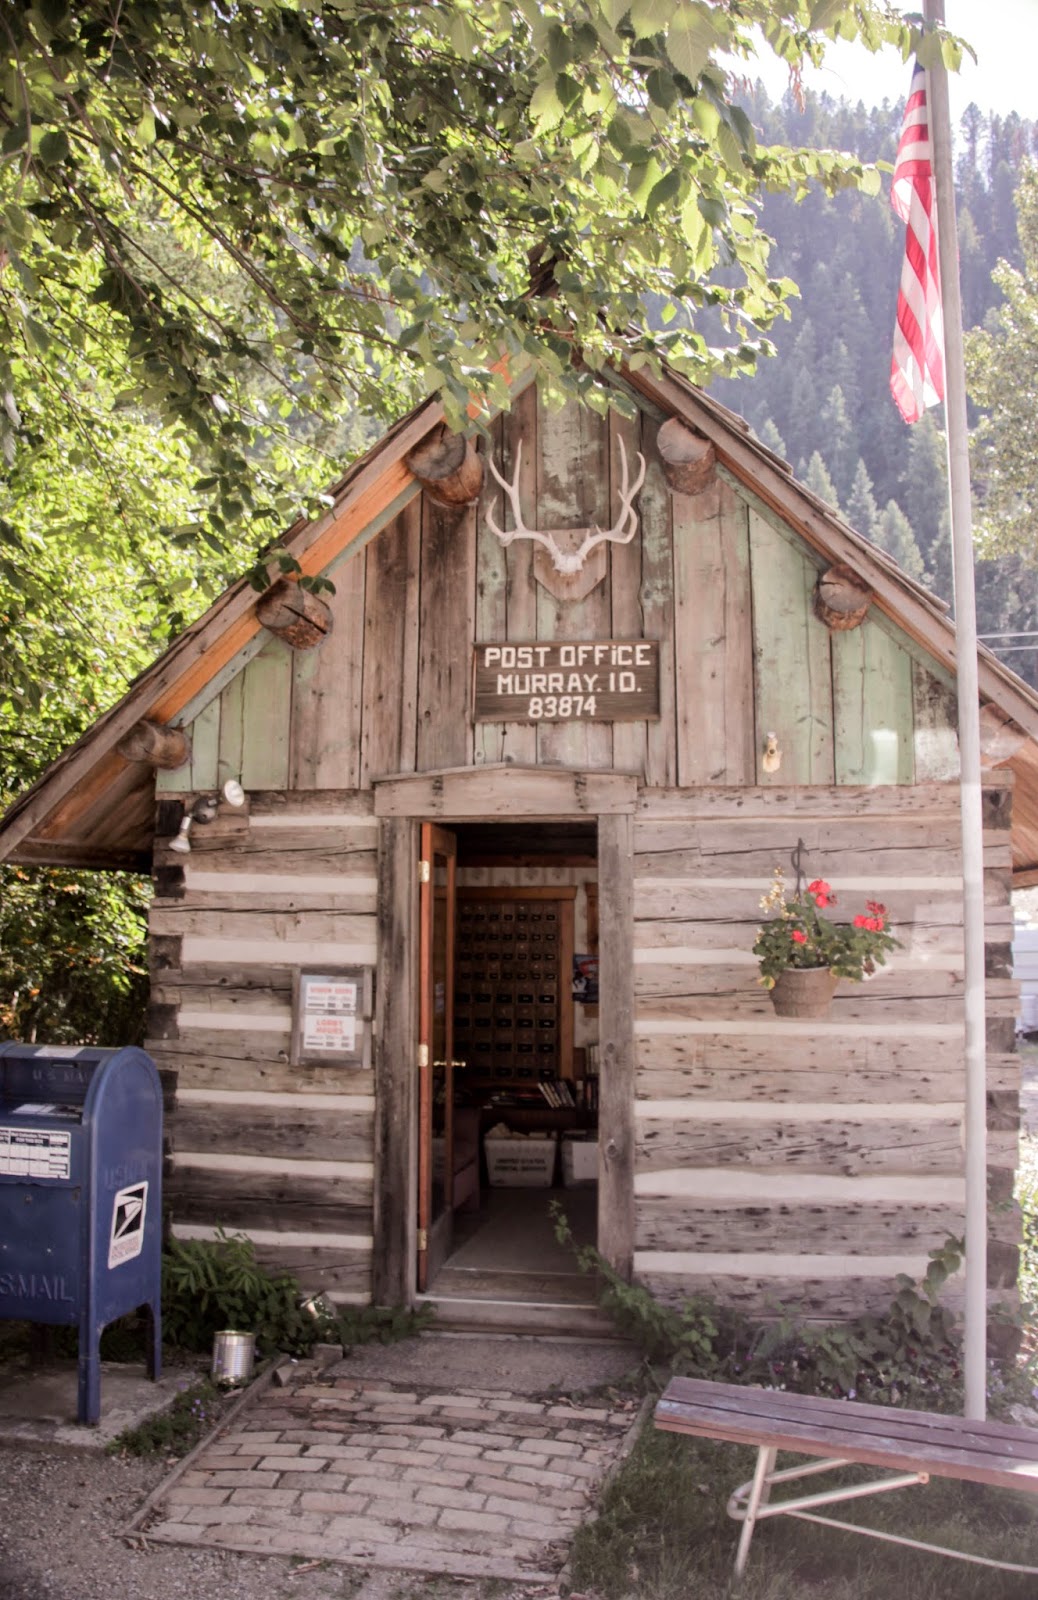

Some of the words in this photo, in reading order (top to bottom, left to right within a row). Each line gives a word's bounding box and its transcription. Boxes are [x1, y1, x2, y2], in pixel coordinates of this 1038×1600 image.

[484, 646, 551, 668] POST
[609, 671, 642, 693] ID.
[528, 695, 597, 718] 83874
